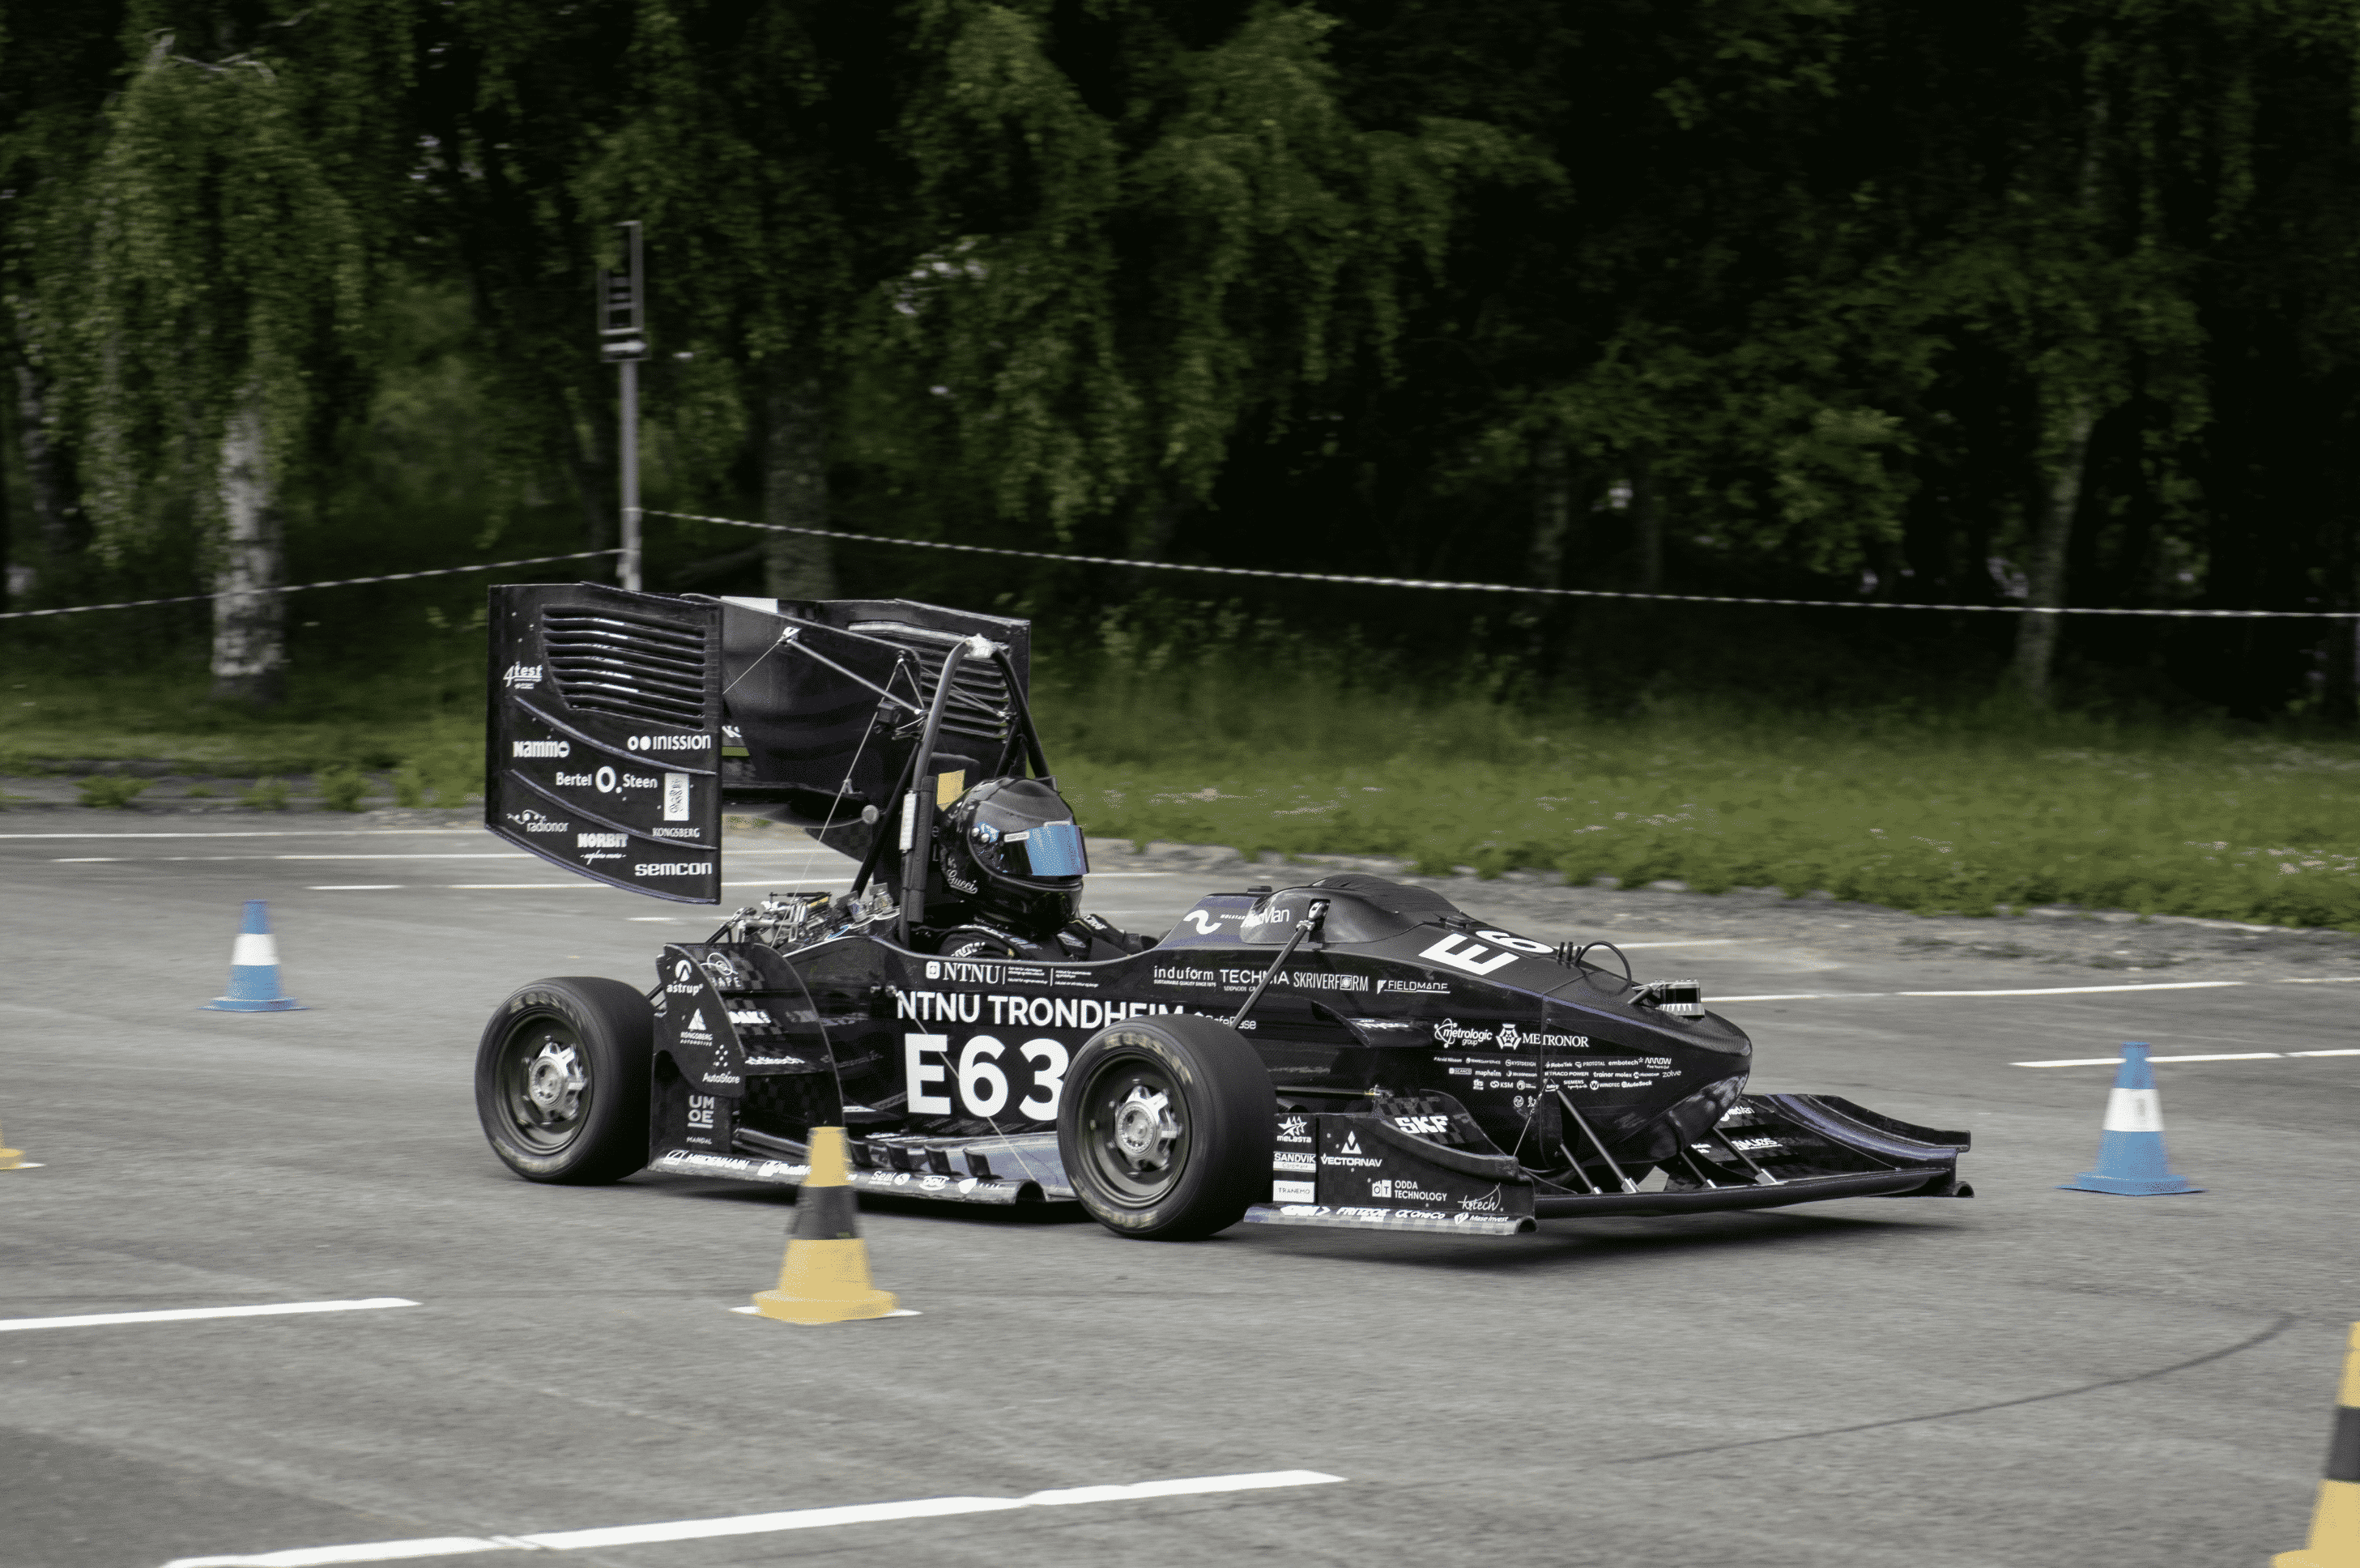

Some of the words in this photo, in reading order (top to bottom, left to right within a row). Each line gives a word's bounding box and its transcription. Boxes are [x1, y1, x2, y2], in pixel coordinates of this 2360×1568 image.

[513, 740, 570, 757] Nammo
[556, 772, 592, 786] Bertel
[622, 773, 658, 788] Steen
[652, 827, 701, 837] KONGSBERG
[577, 833, 628, 847] NORBIT
[634, 862, 712, 876] semcon
[943, 962, 1001, 984] NTNU
[897, 990, 981, 1023] NTNU
[1443, 1028, 1493, 1042] metrologic
[1461, 1038, 1478, 1046] group
[1523, 1032, 1590, 1048] METRONOR
[702, 1071, 740, 1084] AutoStore
[905, 1033, 1069, 1121] E63
[1475, 1069, 1502, 1077] mapheim
[688, 1095, 715, 1110] UM
[688, 1109, 714, 1123] OE
[1395, 1115, 1449, 1134] SKF
[1274, 1153, 1317, 1164] SANDVIK
[1320, 1154, 1382, 1167] VECTORNAV
[1278, 1187, 1310, 1195] TRANEMO
[1395, 1180, 1419, 1190] ODDA
[1395, 1189, 1448, 1202] TECHNOLOGY
